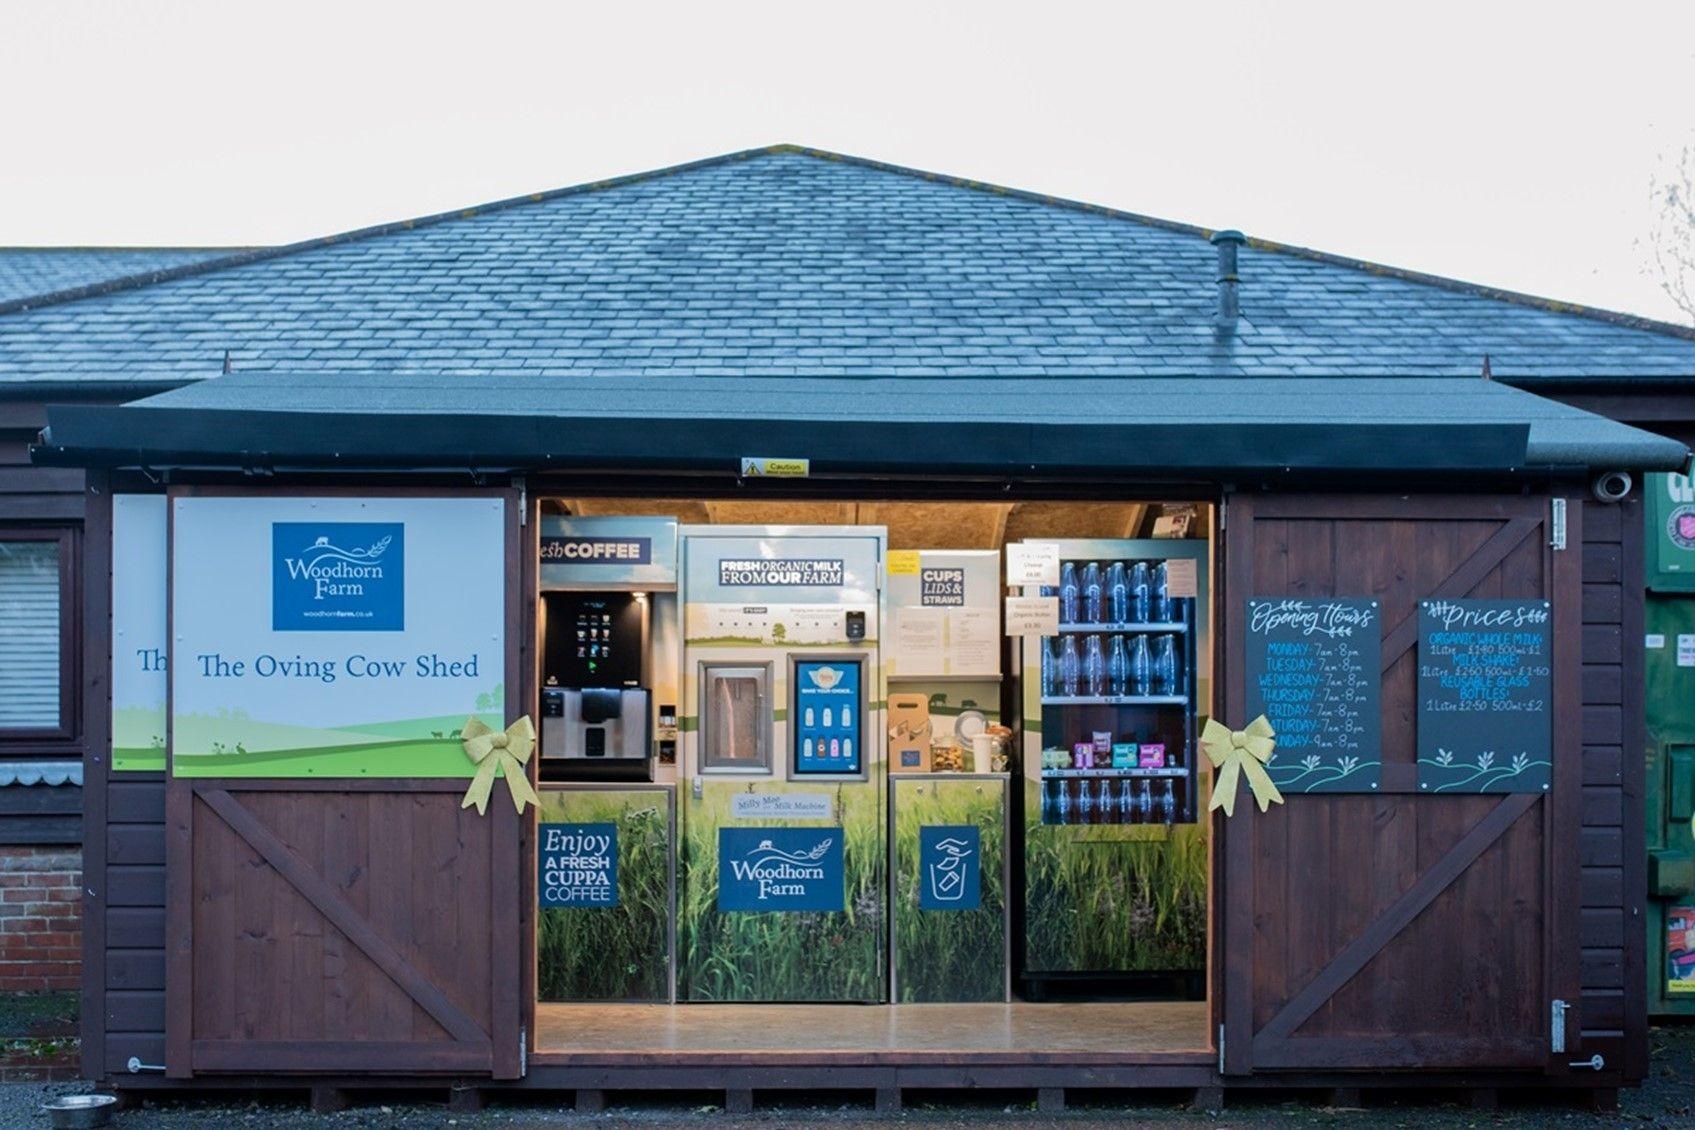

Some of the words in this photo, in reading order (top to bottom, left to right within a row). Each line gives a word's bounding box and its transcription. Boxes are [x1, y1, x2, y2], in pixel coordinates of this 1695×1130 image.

[770, 462, 802, 470] Caution
[540, 541, 563, 558] esh
[564, 543, 640, 558] COFFEE
[285, 558, 384, 580] Woodhorn
[721, 561, 760, 571] FRESH
[761, 561, 813, 572] ORGANIC
[813, 561, 842, 571] MILK
[721, 572, 767, 584] FROM
[767, 572, 801, 584] OUR
[802, 572, 842, 584] FARM
[923, 570, 962, 582] CUPS
[314, 578, 364, 600] Farm
[924, 582, 952, 594] LIDS
[952, 583, 962, 594] &
[923, 596, 962, 604] STRAWS
[303, 610, 374, 618] woodhornfarm.co.uk
[1251, 602, 1319, 635] Opening
[1319, 603, 1374, 628] Hours
[1443, 604, 1526, 631] Prices
[137, 649, 167, 671] Th
[198, 653, 245, 678] The
[254, 654, 337, 683] Oving
[346, 655, 406, 678] Cow
[416, 654, 479, 678] Shed
[545, 829, 610, 857] Enjoy
[545, 856, 558, 869] A
[560, 856, 610, 869] FRESH
[730, 860, 824, 881] Woodhorn
[544, 870, 611, 886] CUPPA
[545, 886, 611, 902] COFFEE
[758, 879, 805, 900] Farm
